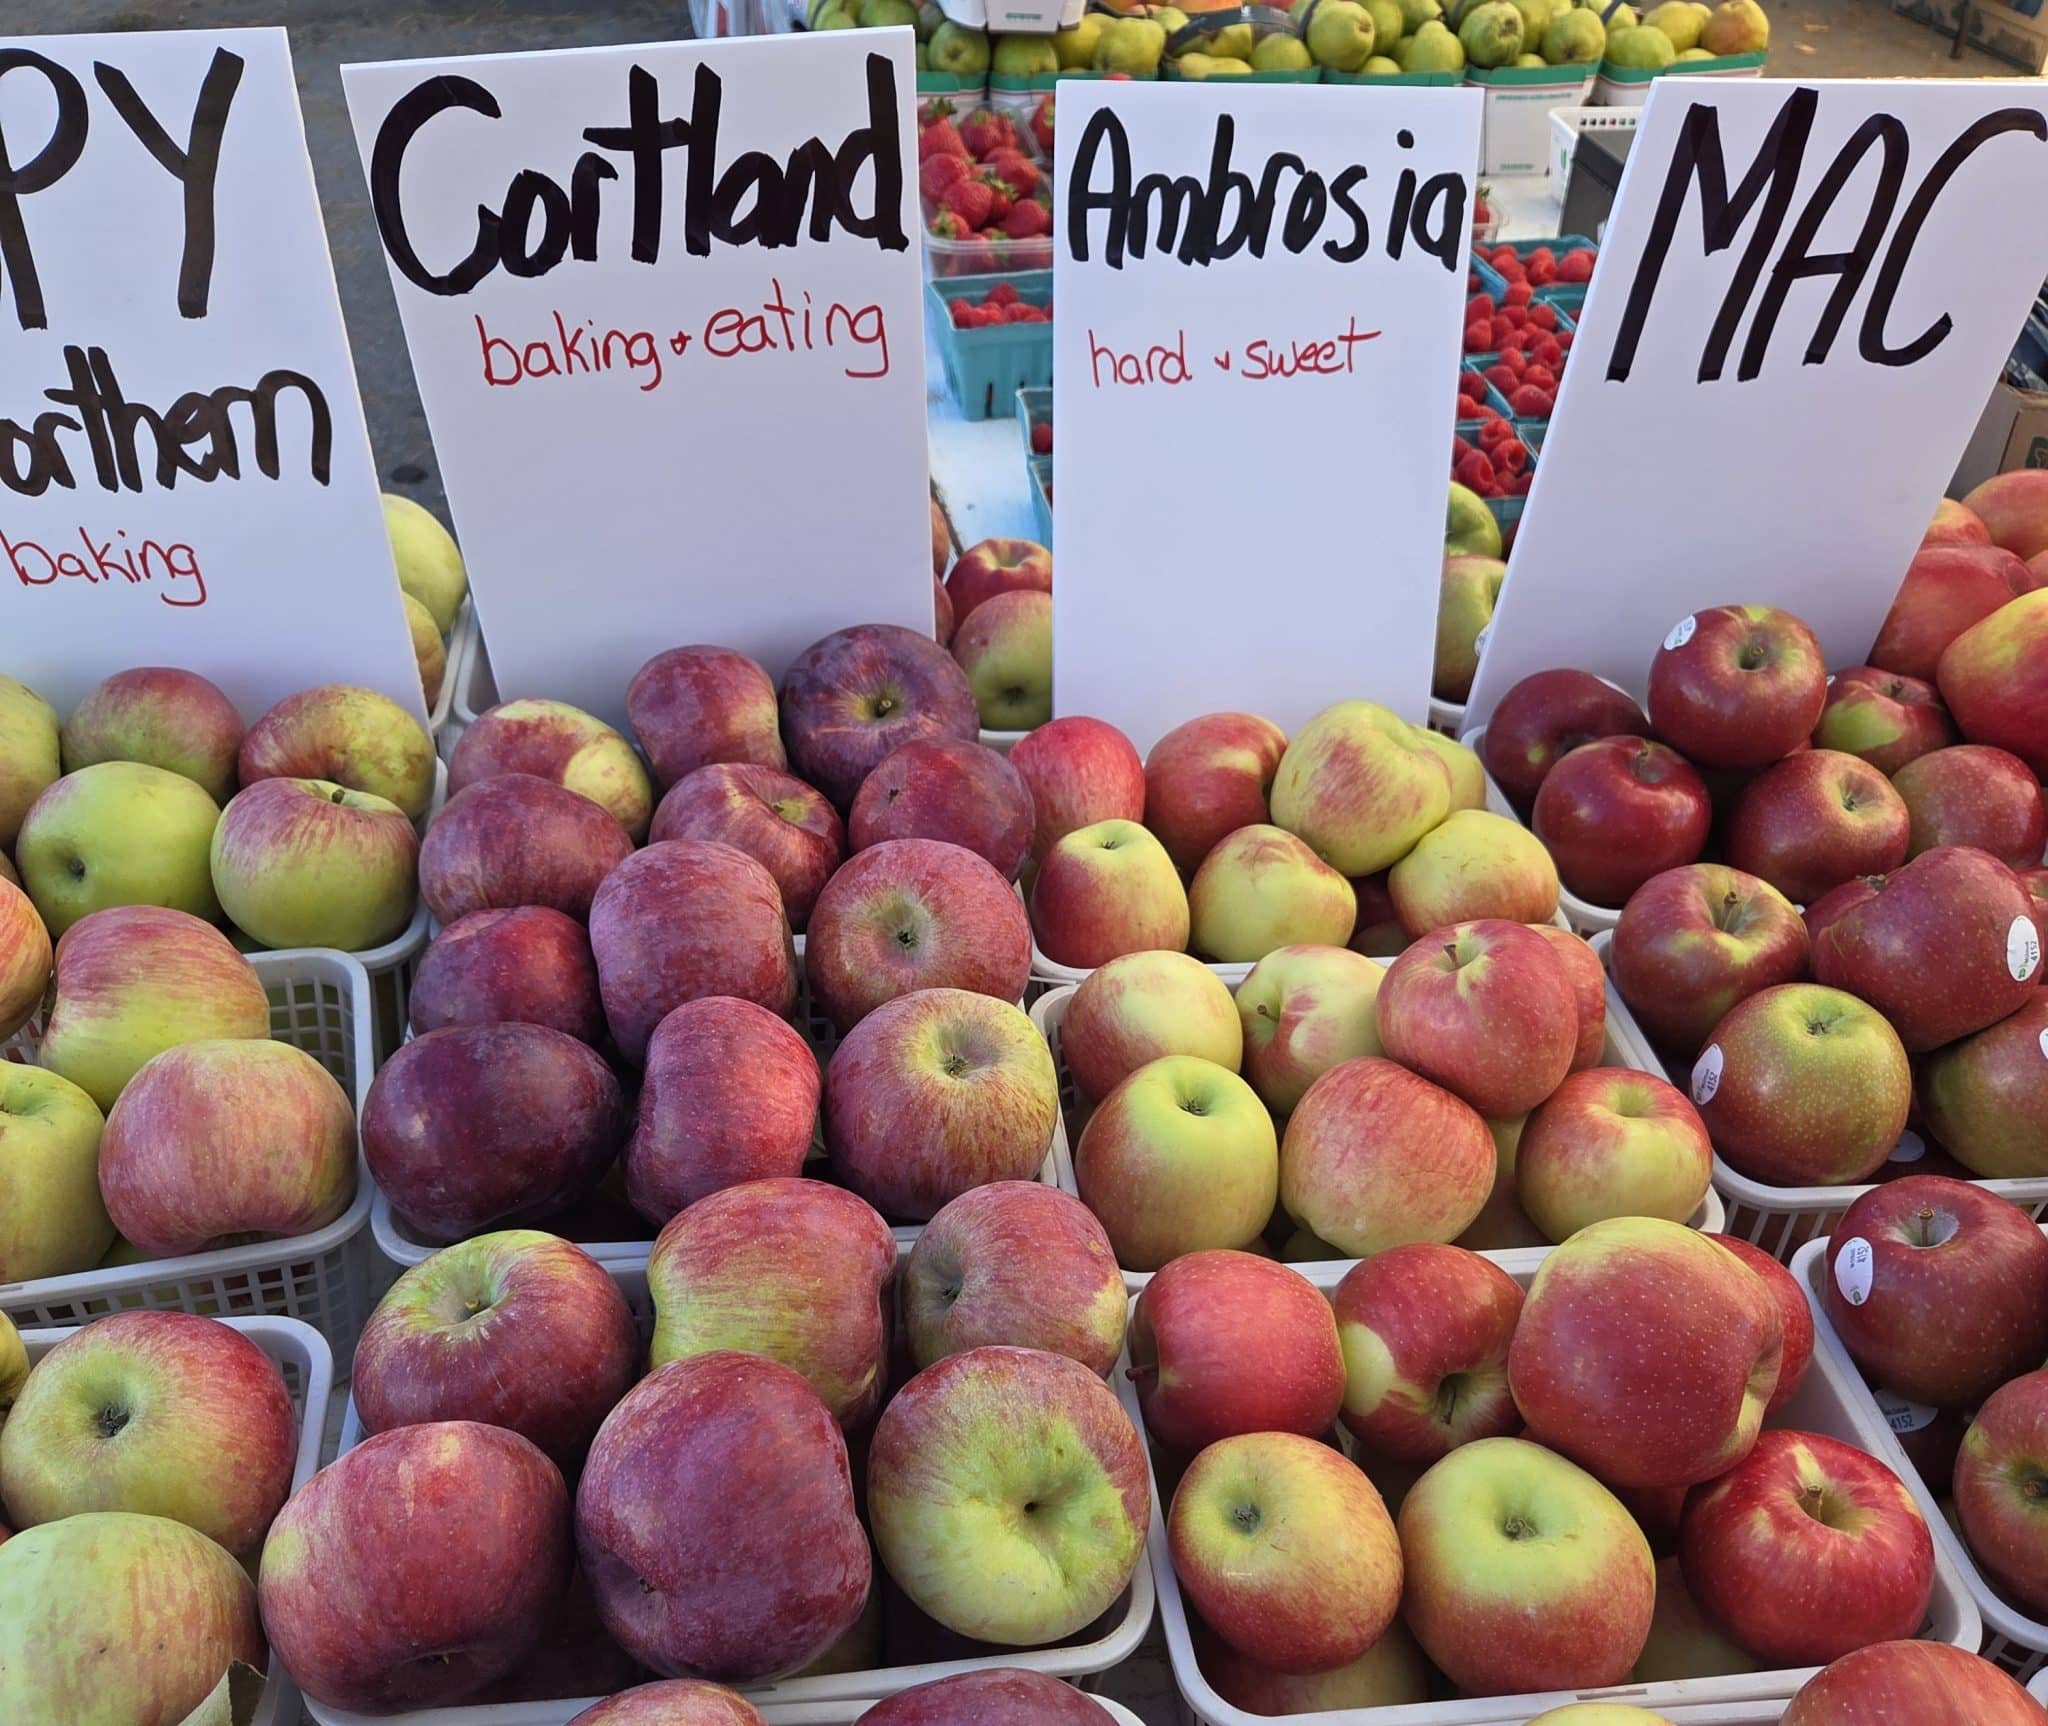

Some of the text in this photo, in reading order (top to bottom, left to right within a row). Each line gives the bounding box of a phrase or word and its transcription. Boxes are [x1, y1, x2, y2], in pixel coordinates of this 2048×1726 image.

[0, 46, 245, 331] PY
[370, 53, 911, 296] Cortland
[1068, 107, 1467, 271] Ambrosia
[1604, 87, 2048, 384] MAC
[473, 310, 662, 392] baking
[704, 277, 890, 379] eating
[1087, 328, 1193, 389] hard
[1240, 315, 1382, 380] sweet
[0, 526, 207, 608] baking
